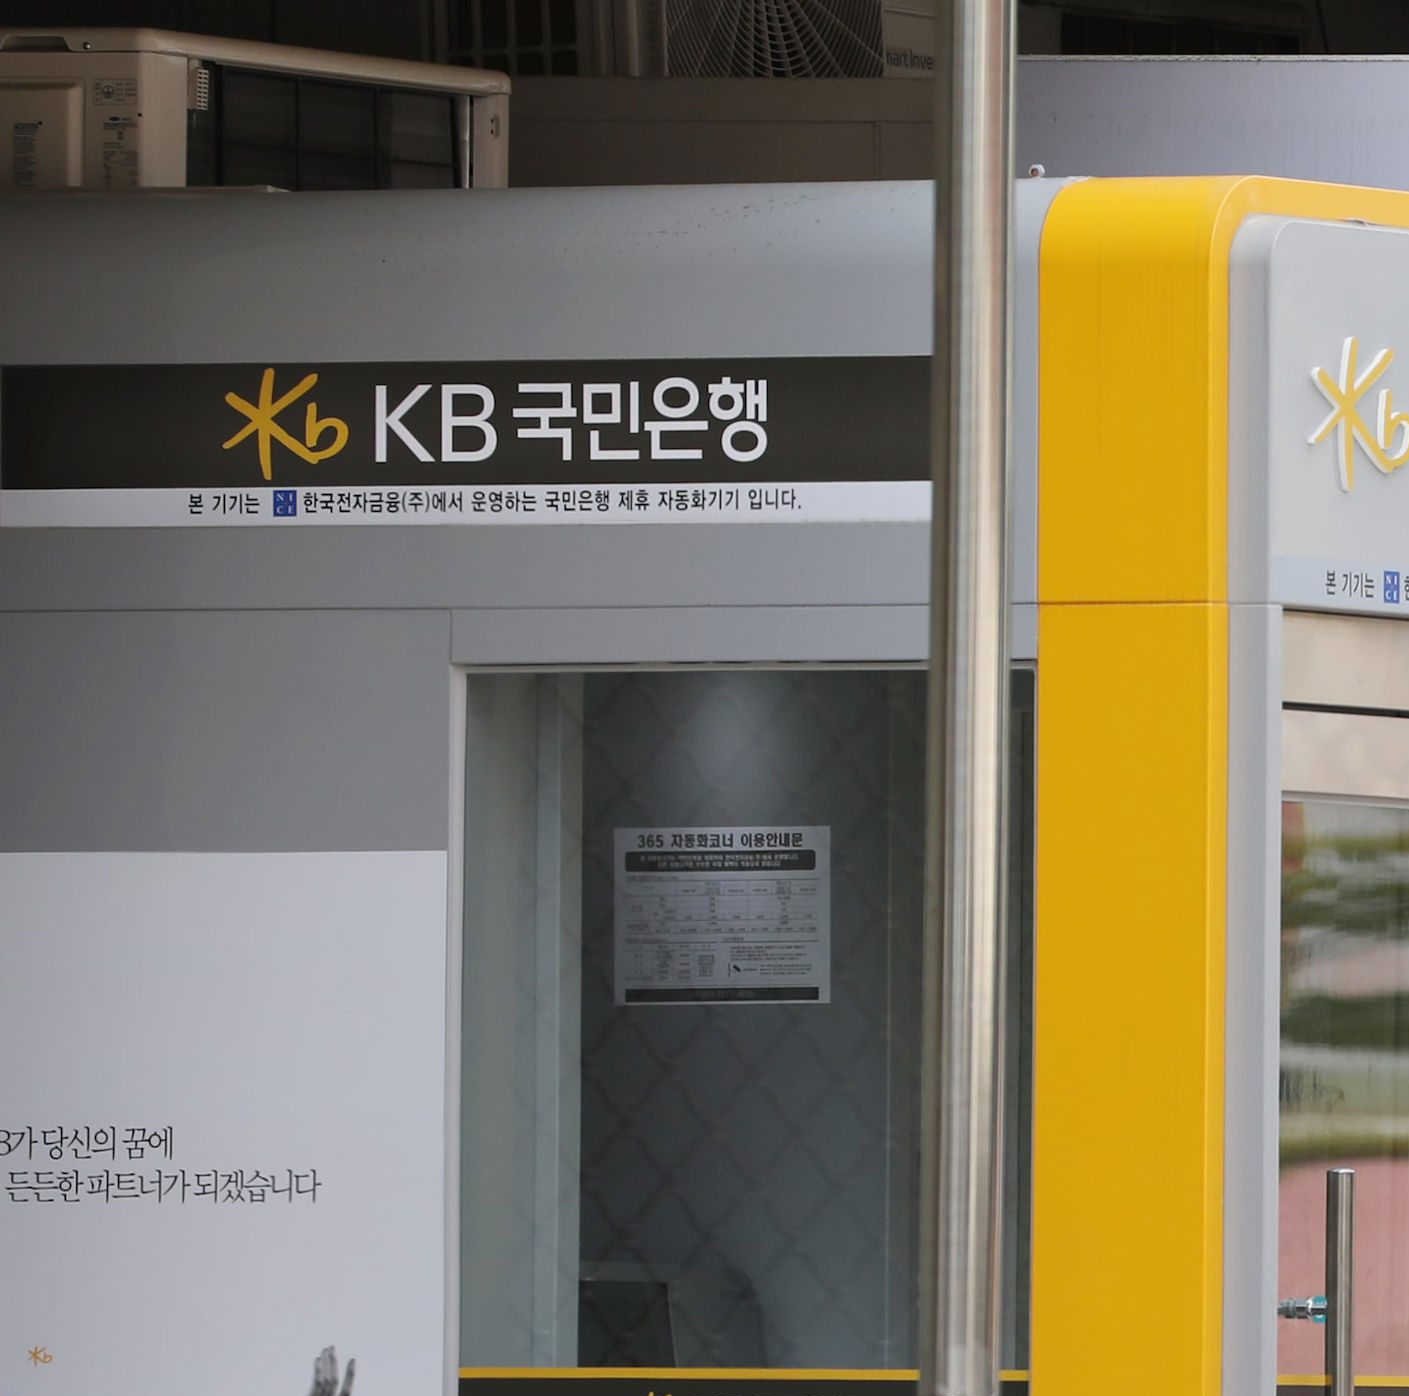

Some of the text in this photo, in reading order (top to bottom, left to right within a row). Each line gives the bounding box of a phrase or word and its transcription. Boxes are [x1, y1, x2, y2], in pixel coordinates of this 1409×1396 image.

[188, 493, 204, 515] 본
[212, 492, 260, 515] 기기는
[303, 491, 464, 514] 한국전자금융(주)에서
[471, 490, 537, 513] 운영하는
[544, 489, 610, 512] 국민은행
[618, 488, 651, 511] 제휴
[658, 488, 740, 512] 자동화기기
[747, 487, 803, 511] 입니다.
[1325, 569, 1337, 597] 본
[1341, 570, 1376, 600] 기기는
[637, 832, 804, 849] 365 자동화코너 이용안내문
[41, 1125, 118, 1161] 당신의
[122, 1125, 175, 1161] 꿈에
[5, 1168, 322, 1205] 든든한 파트너가 되겠습니다
